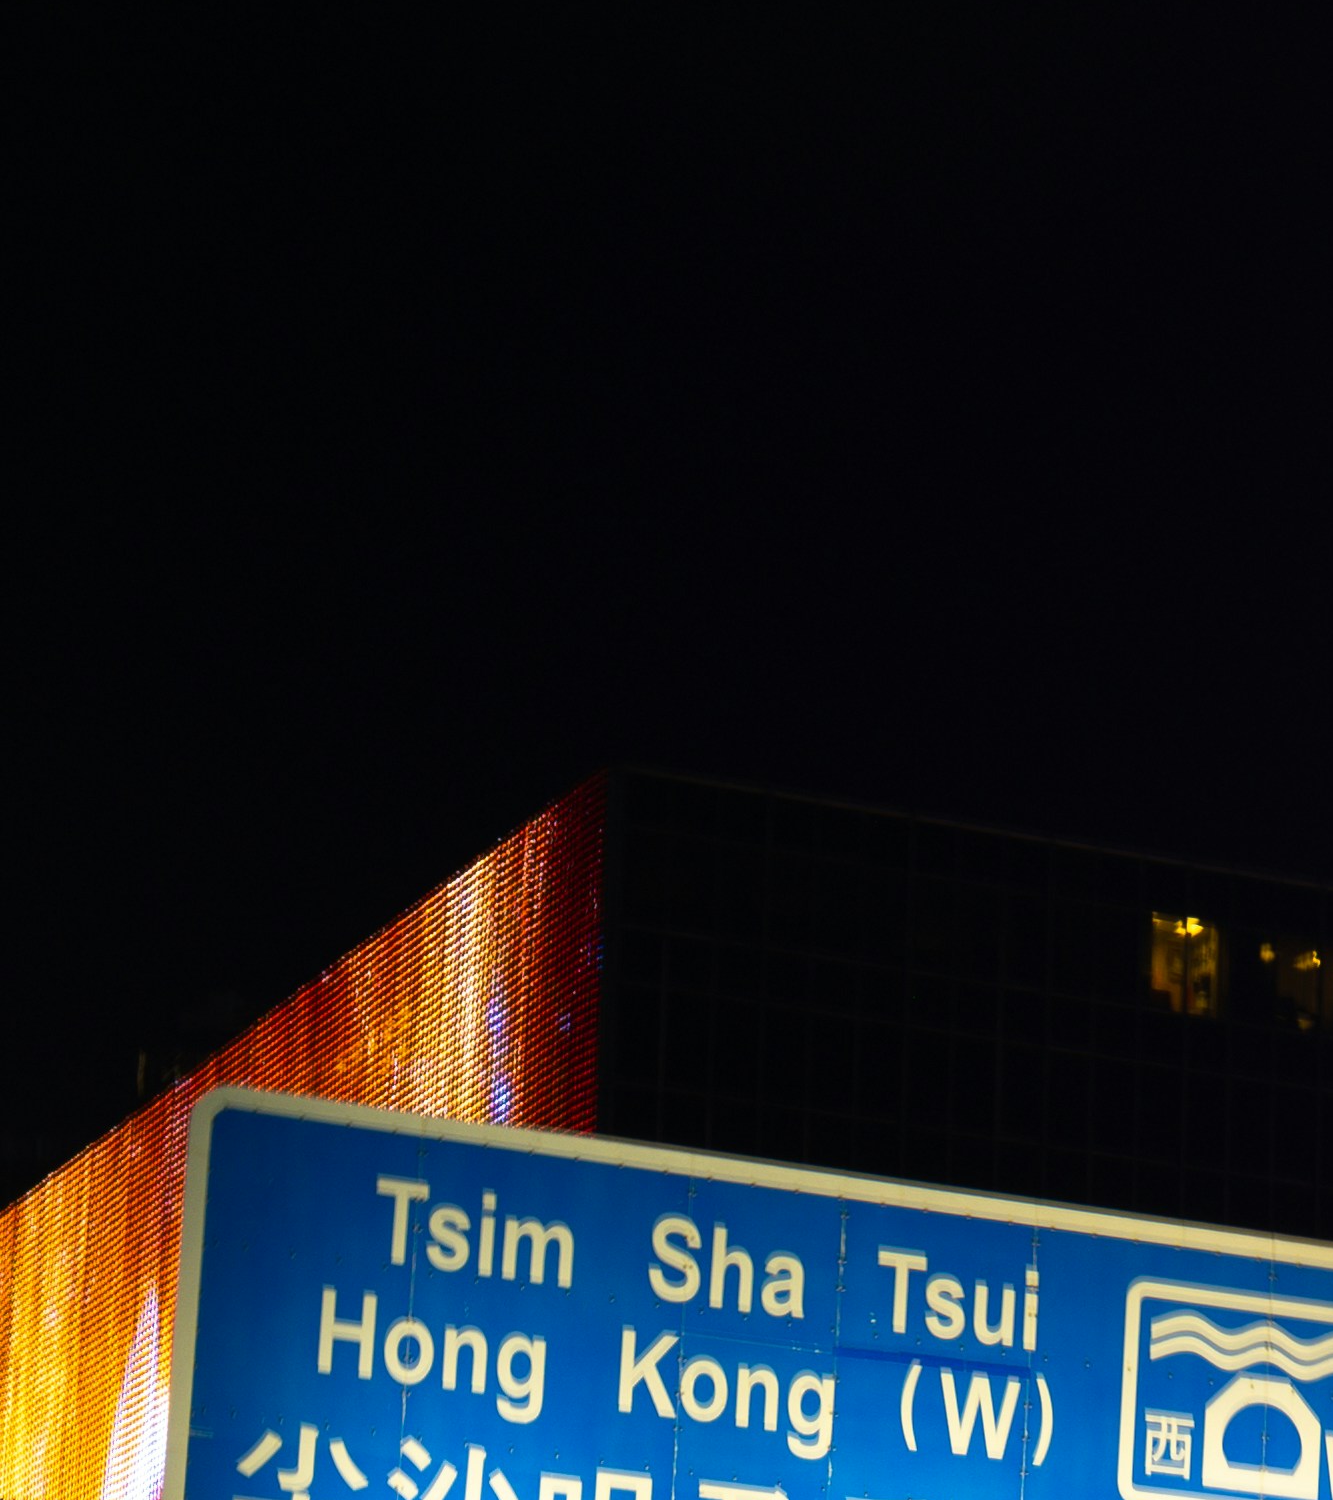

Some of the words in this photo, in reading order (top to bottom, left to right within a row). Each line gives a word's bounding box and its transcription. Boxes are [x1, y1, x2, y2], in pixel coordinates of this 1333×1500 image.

[375, 1173, 574, 1289] Tsim
[651, 1214, 806, 1319] Sha
[878, 1246, 1039, 1352] Tsui
[318, 1287, 548, 1425] Hong
[618, 1329, 837, 1460] Kong
[899, 1358, 1056, 1467] (W)
[1144, 1407, 1195, 1479] 西
